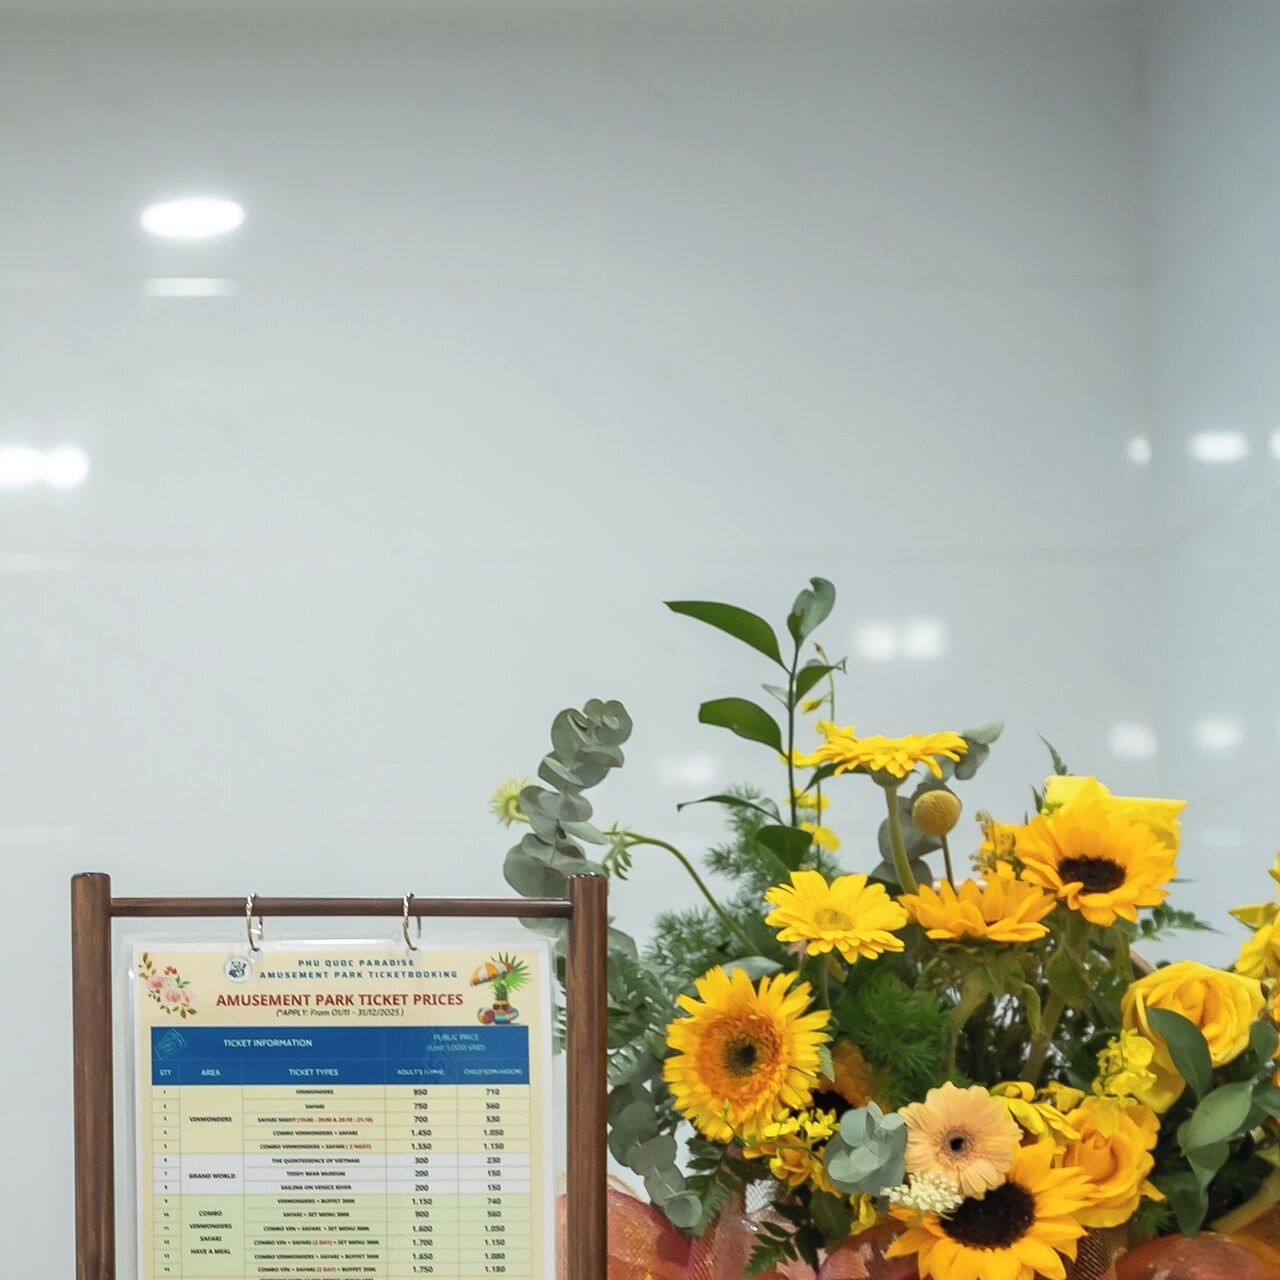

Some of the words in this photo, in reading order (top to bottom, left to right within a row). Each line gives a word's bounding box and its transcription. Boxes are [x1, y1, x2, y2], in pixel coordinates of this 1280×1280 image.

[359, 959, 414, 968] PARADISE
[259, 970, 329, 979] AMUSEMENT
[334, 970, 363, 979] PARK
[216, 994, 311, 1006] AMUSEMENT
[315, 994, 355, 1006] PARK
[357, 994, 409, 1006] TICKET
[413, 994, 464, 1006] PRICES
[223, 1039, 251, 1047] TICKET
[253, 1039, 313, 1047] INFORMATION
[288, 1068, 313, 1076] TICKET
[317, 1068, 339, 1076] TYPES
[485, 1088, 500, 1096] 710
[413, 1102, 428, 1110] 750
[413, 1115, 428, 1123] 700
[411, 1129, 432, 1137] 1.450
[483, 1142, 504, 1150] 1.150
[486, 1156, 501, 1164] 230
[487, 1169, 501, 1177] 150
[415, 1184, 429, 1192] 200
[415, 1210, 430, 1218] 900
[412, 1225, 433, 1233] 1.600
[412, 1239, 433, 1247] 1.700
[413, 1265, 434, 1273] 1.750
